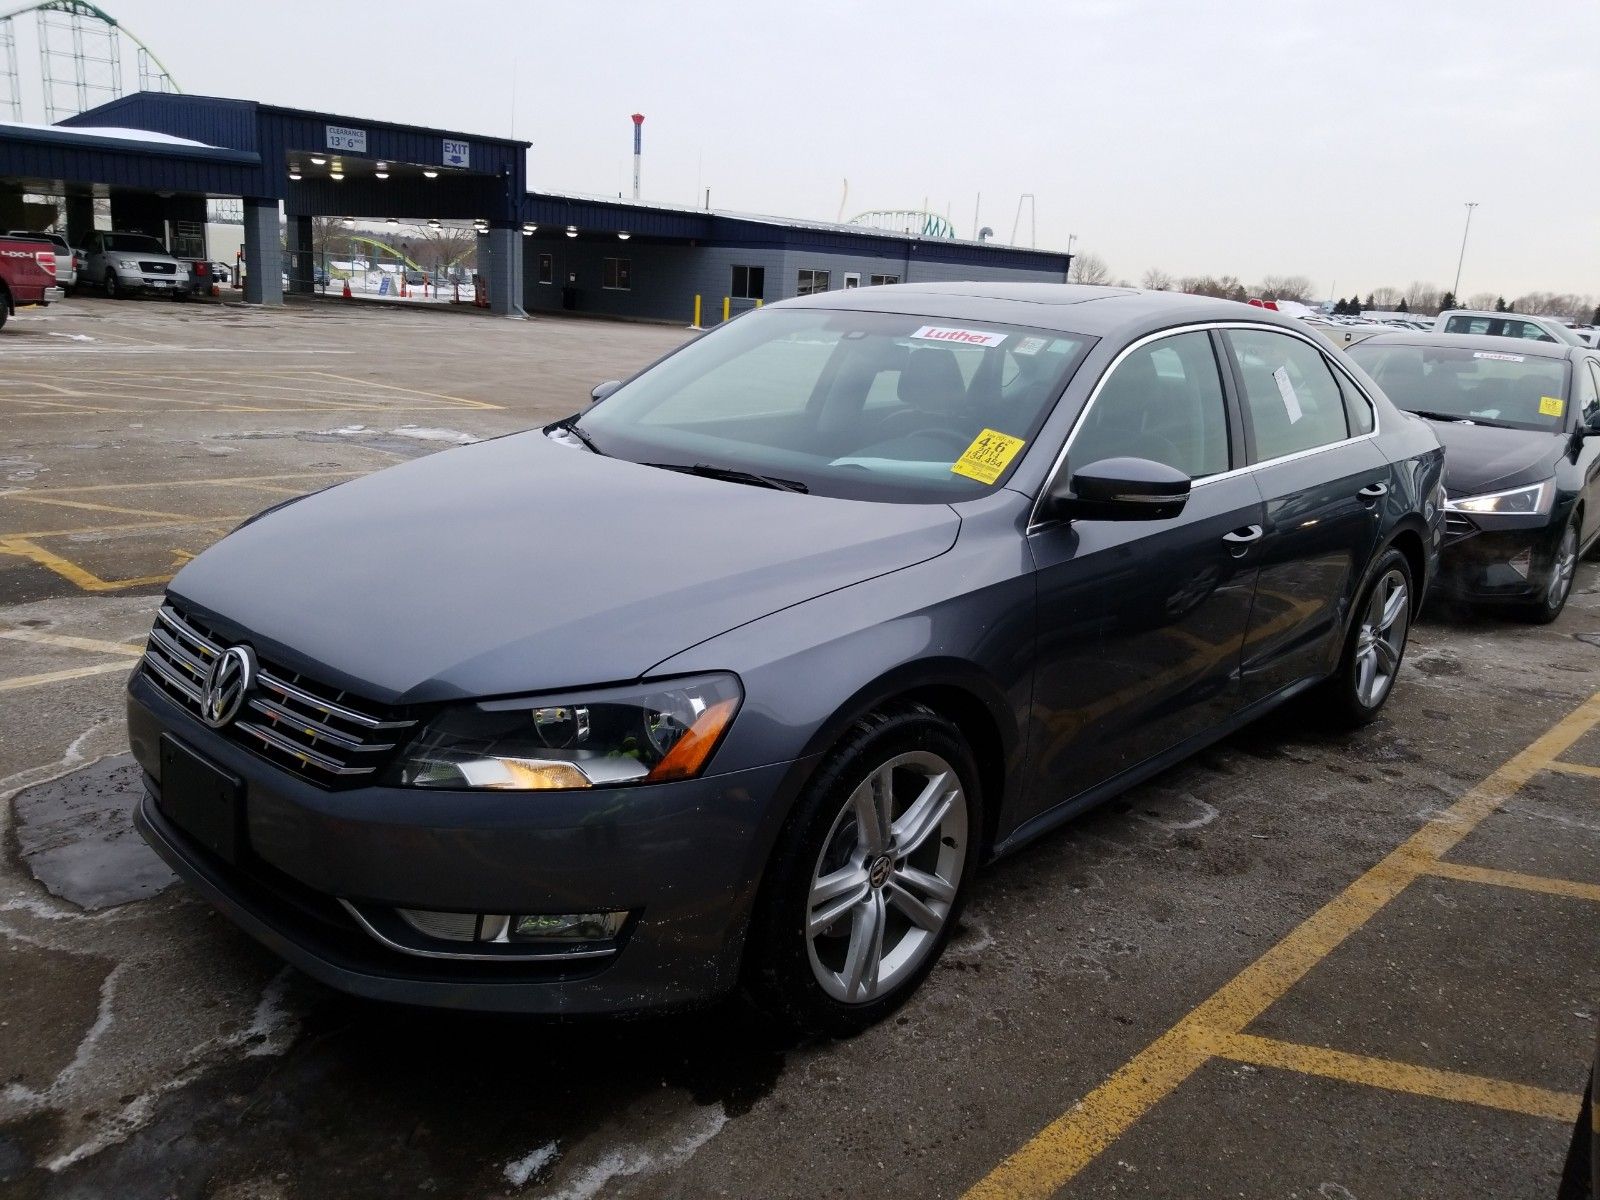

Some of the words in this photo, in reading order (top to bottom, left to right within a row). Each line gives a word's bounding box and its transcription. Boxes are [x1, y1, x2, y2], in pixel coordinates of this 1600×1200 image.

[329, 127, 364, 138] CLEARANCE
[330, 136, 340, 146] 13
[347, 139, 354, 148] 6
[444, 142, 468, 155] EXIT
[924, 328, 993, 344] Luther
